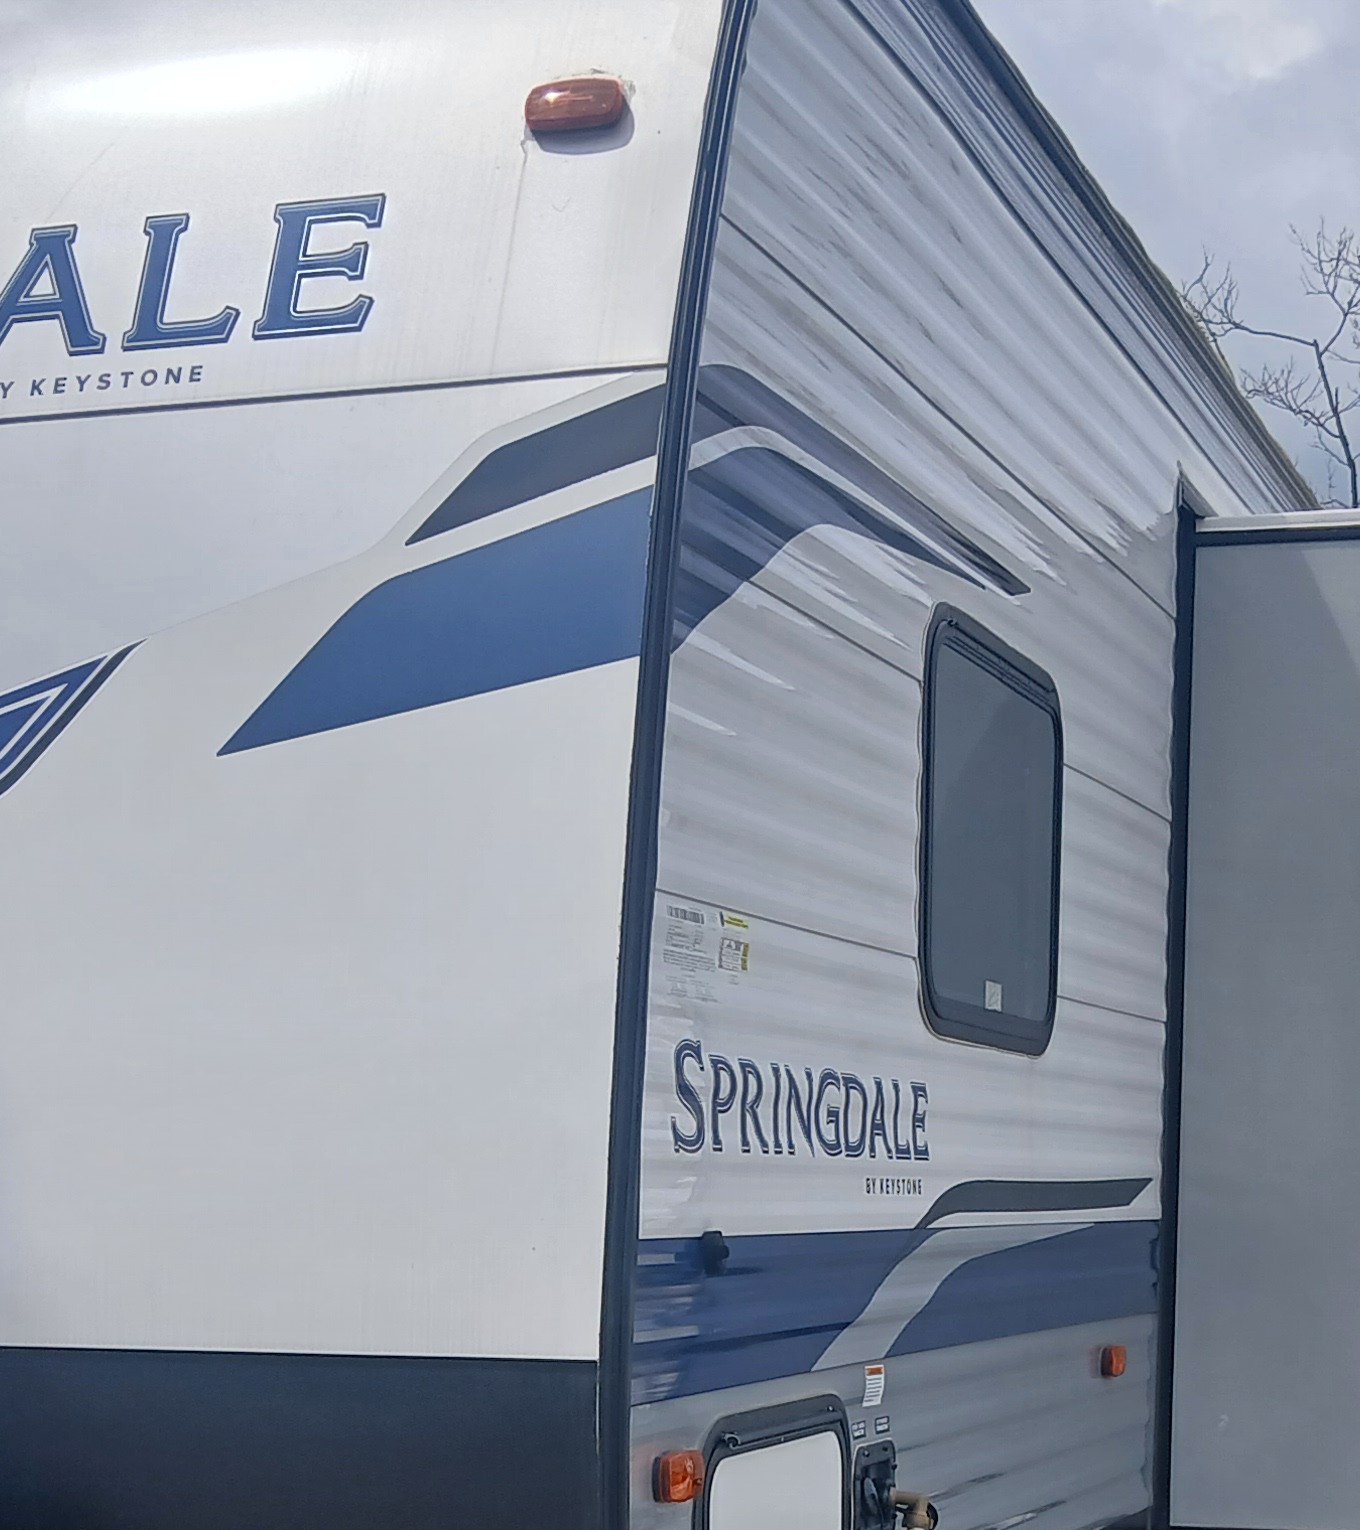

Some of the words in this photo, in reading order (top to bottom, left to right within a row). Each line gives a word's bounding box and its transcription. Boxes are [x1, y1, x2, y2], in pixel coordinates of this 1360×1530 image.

[30, 365, 203, 396] KEYSTONE
[671, 1039, 930, 1162] SPRINGDALE
[865, 1178, 876, 1194] BY
[879, 1178, 922, 1195] KEYSTONE
